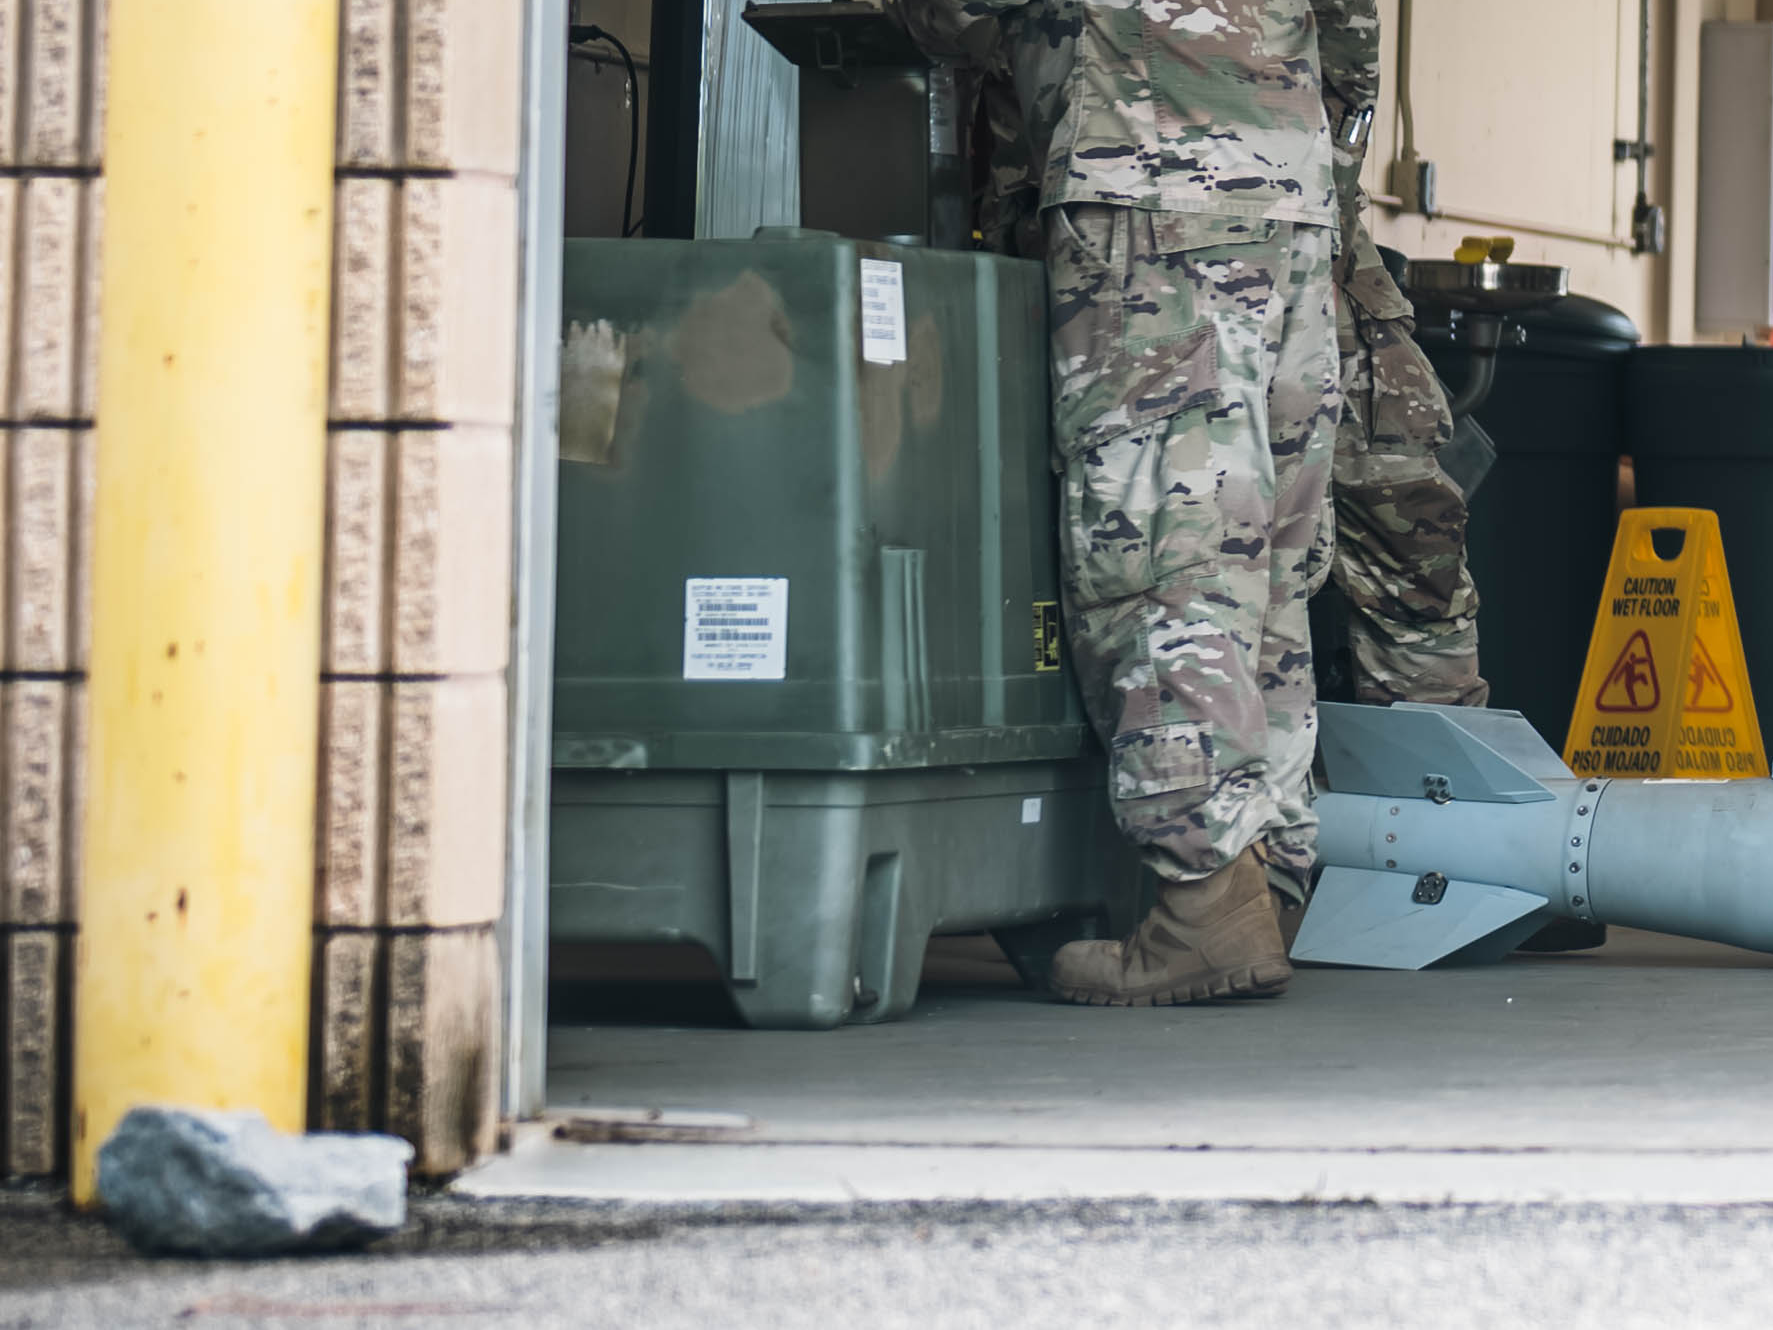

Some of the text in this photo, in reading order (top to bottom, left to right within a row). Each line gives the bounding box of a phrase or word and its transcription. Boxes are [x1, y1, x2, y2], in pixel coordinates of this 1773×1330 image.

[1624, 577, 1677, 596] CAUTION
[1612, 598, 1681, 618] WET FLOOR
[1591, 725, 1650, 747] CUIDADO
[1572, 749, 1661, 774] PISO MOJADO
